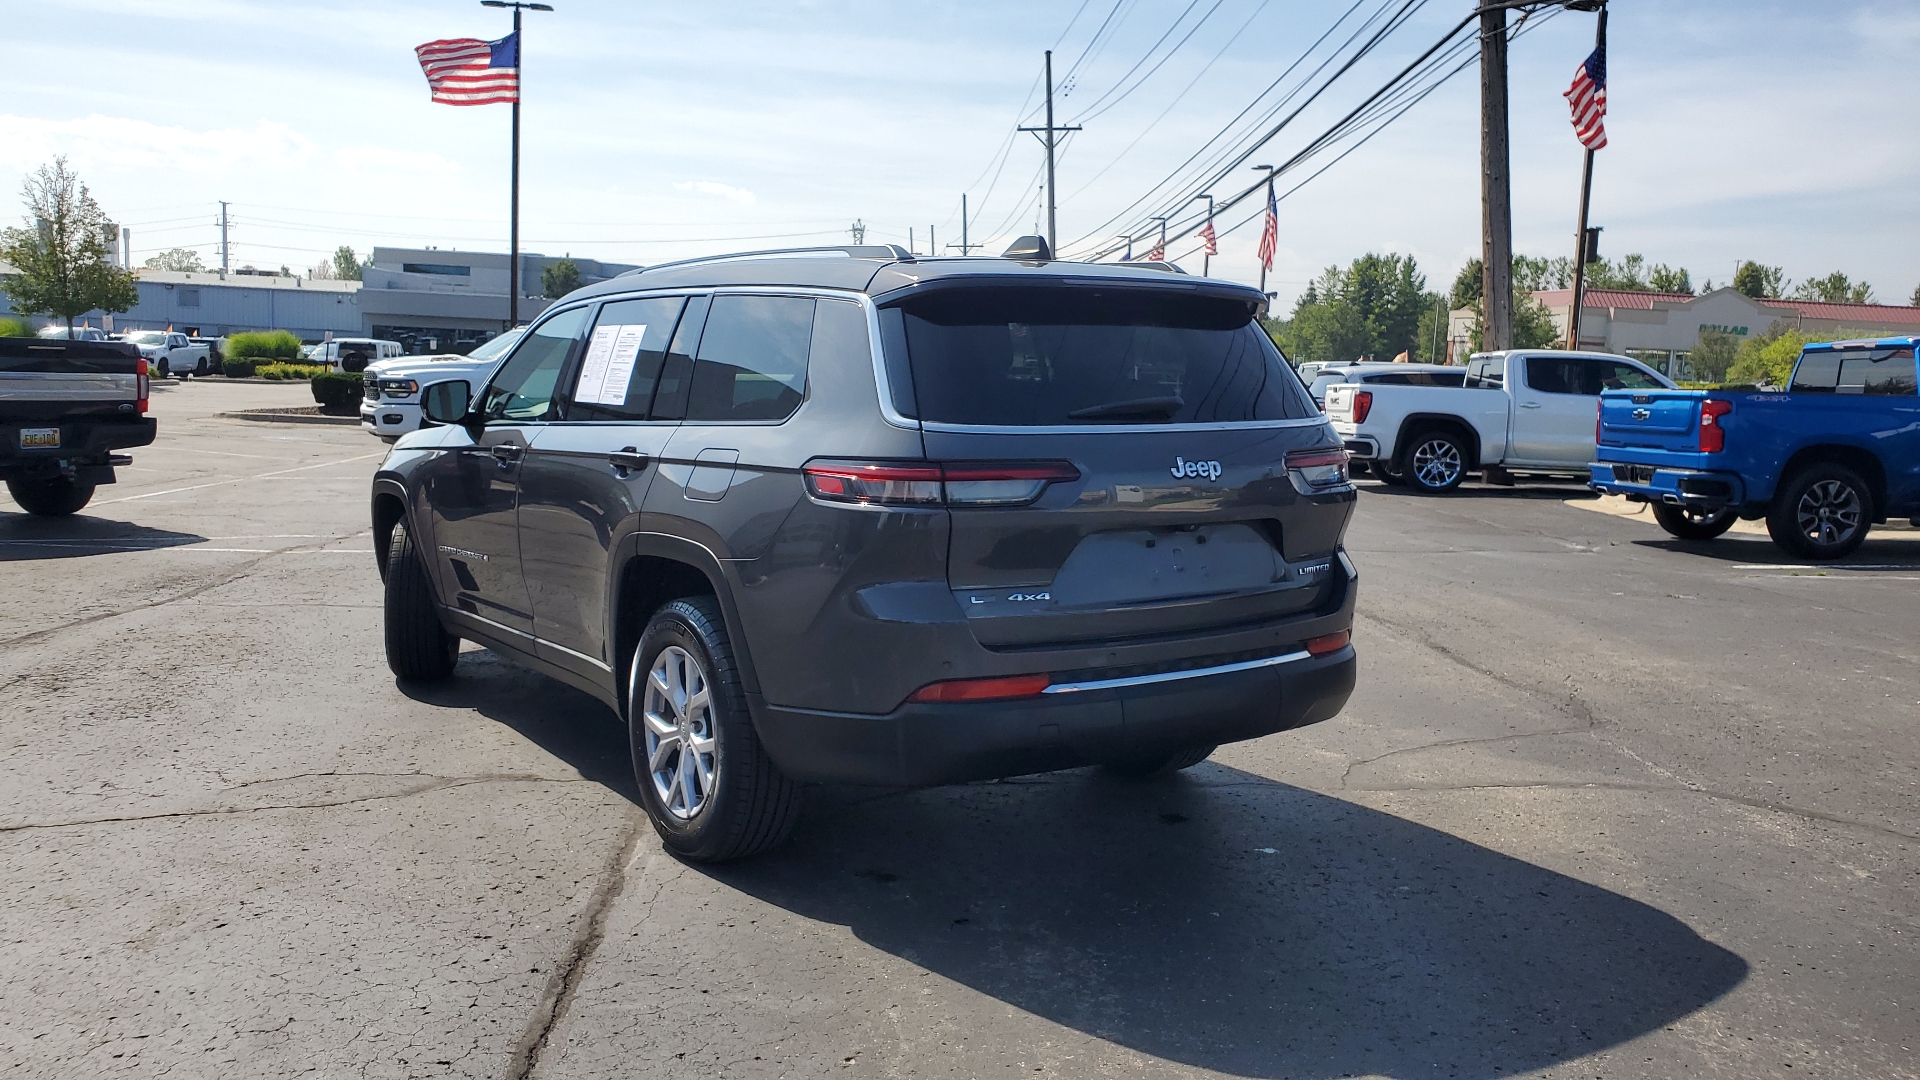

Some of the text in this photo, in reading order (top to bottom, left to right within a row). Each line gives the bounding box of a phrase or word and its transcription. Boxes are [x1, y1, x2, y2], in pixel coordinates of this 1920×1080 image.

[1170, 456, 1222, 481] Jeep
[1299, 563, 1330, 575] LIMITED
[970, 592, 1051, 604] L 4x4
